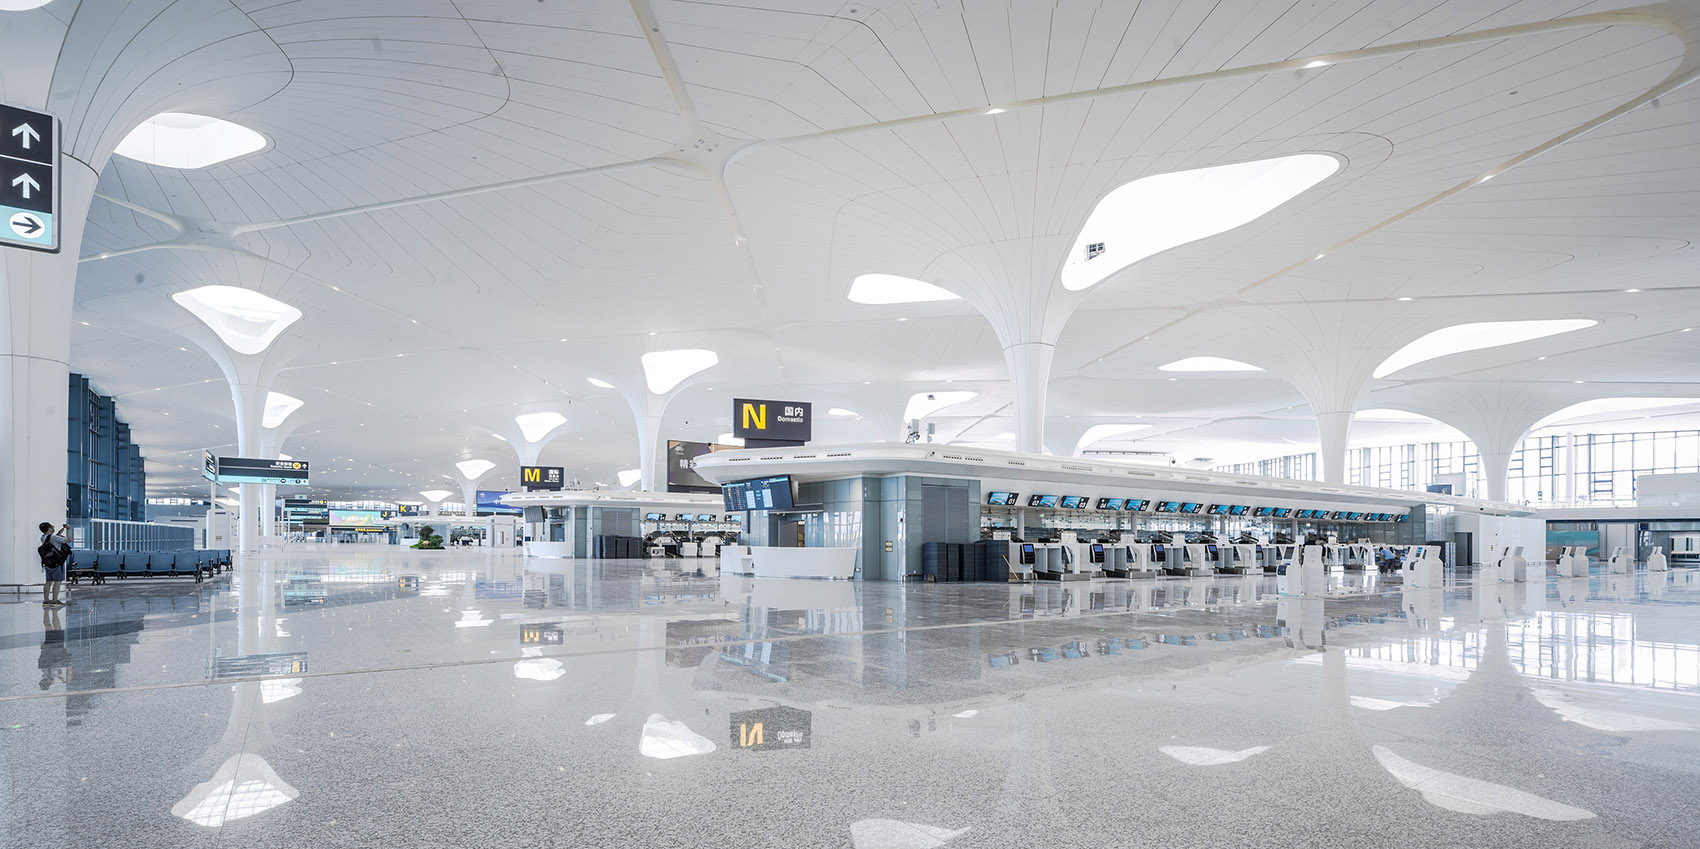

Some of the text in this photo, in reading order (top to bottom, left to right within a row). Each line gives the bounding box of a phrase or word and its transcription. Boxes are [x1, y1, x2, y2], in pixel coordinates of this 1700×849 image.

[742, 403, 766, 430] N
[784, 406, 804, 417] 国内
[524, 468, 540, 482] M
